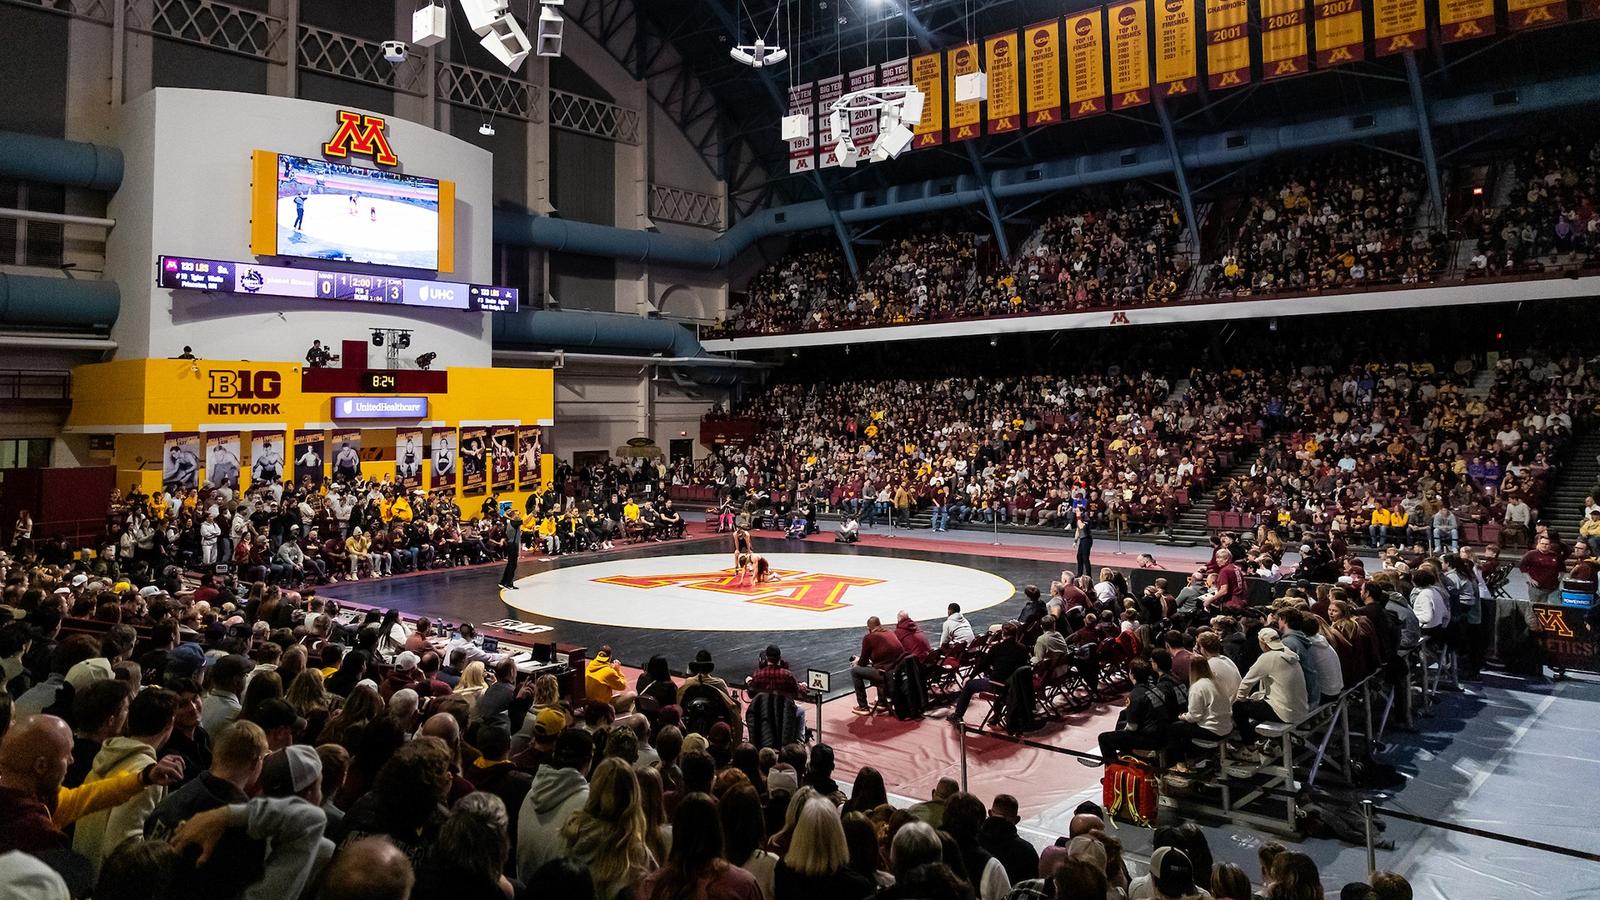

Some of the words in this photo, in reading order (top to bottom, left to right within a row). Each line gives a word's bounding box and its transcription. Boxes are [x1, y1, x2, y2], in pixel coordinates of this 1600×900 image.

[1208, 2, 1245, 14] CHAMPIONS
[1323, 0, 1353, 16] 2007
[1269, 13, 1298, 29] 2002
[1214, 26, 1240, 41] 2001
[1388, 34, 1414, 51] M
[1329, 47, 1352, 63] M
[883, 69, 893, 78] BIG
[895, 64, 907, 74] TEN
[1275, 60, 1297, 74] M
[851, 77, 861, 85] BIG
[863, 73, 874, 82] TEN
[1219, 72, 1240, 86] M
[801, 89, 811, 98] TEN
[820, 84, 829, 93] BIG
[831, 82, 842, 90] TEN
[1168, 81, 1186, 94] M
[1122, 92, 1140, 105] M
[1079, 100, 1097, 113] M
[855, 109, 872, 119] 2001
[1036, 110, 1053, 122] M
[996, 118, 1012, 130] M
[856, 125, 873, 136] 2002
[957, 126, 972, 137] M
[325, 111, 398, 166] M
[794, 139, 809, 148] 1913
[921, 134, 935, 145] M
[859, 146, 870, 157] M
[796, 159, 808, 169] M
[826, 154, 838, 163] M
[195, 263, 208, 272] LBS
[322, 281, 330, 294] 0
[342, 276, 346, 284] 1
[353, 278, 370, 287] 2:00
[377, 279, 382, 287] 7
[391, 287, 399, 299] 3
[430, 288, 454, 300] UHC
[1110, 312, 1130, 324] M
[372, 376, 394, 387] 8:24
[208, 403, 280, 415] NETWORK
[356, 402, 420, 412] UnitedHealthcare
[588, 568, 889, 612] M
[812, 679, 823, 688] M
